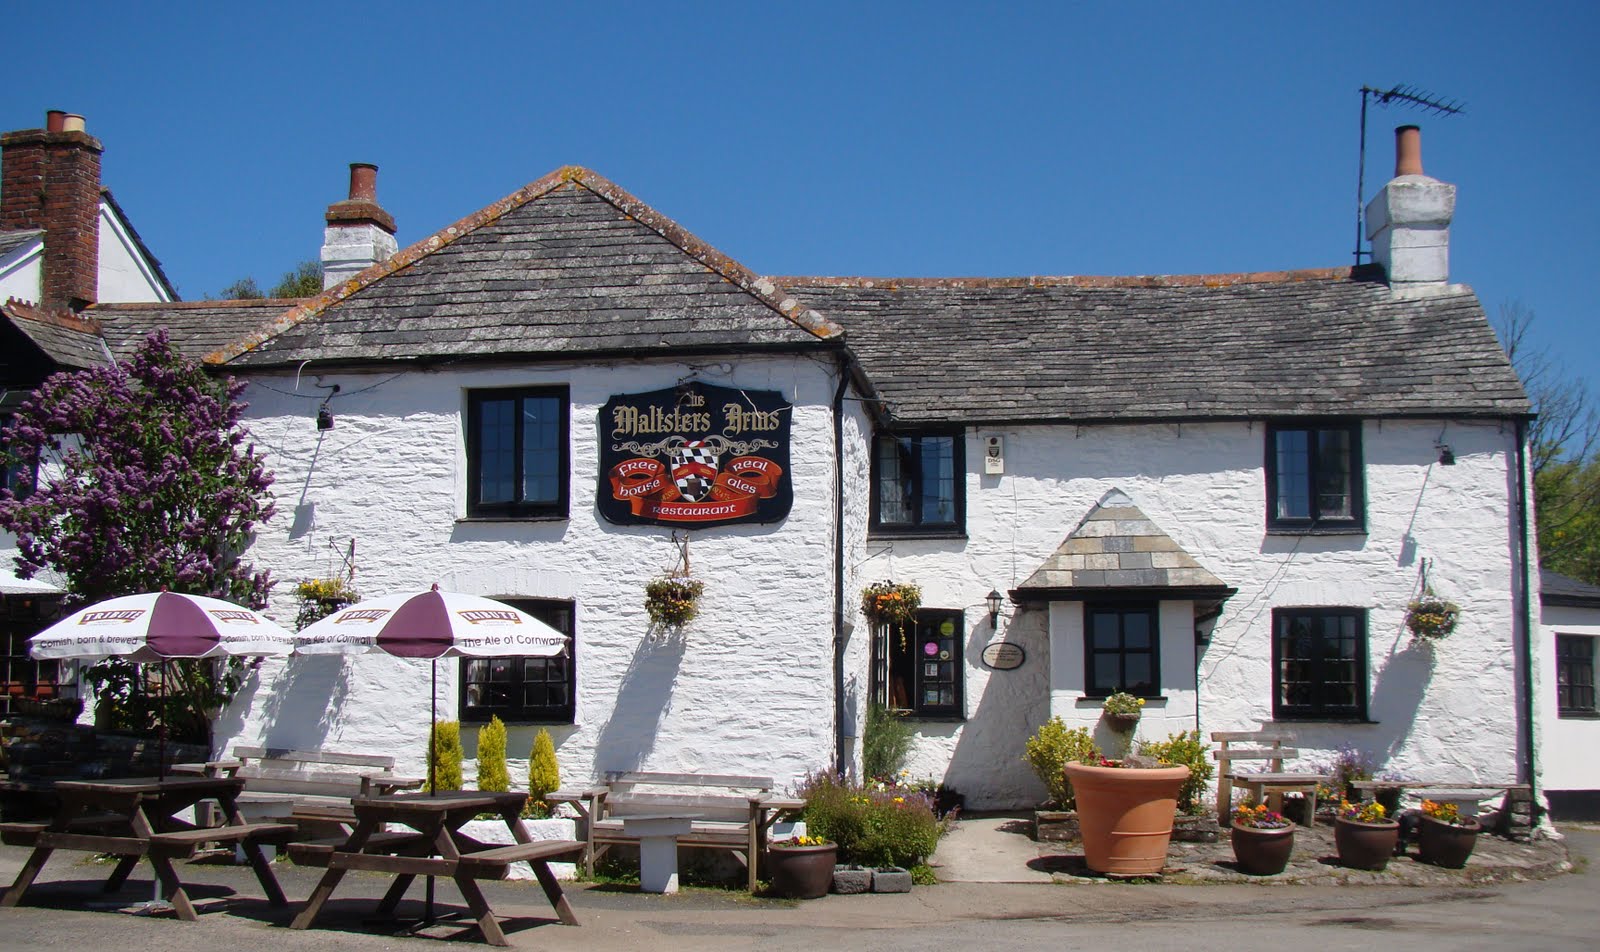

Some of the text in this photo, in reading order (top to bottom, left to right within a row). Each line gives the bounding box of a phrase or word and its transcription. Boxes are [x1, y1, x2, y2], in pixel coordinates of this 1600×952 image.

[612, 403, 780, 440] Maltsters Arms
[84, 610, 144, 621] TRIBUTE
[342, 610, 390, 621] TRIBUTE
[460, 610, 518, 621] TRIBUTE
[40, 635, 138, 649] Cornish, born & brewed
[463, 638, 481, 648] The
[484, 635, 501, 646] Ale
